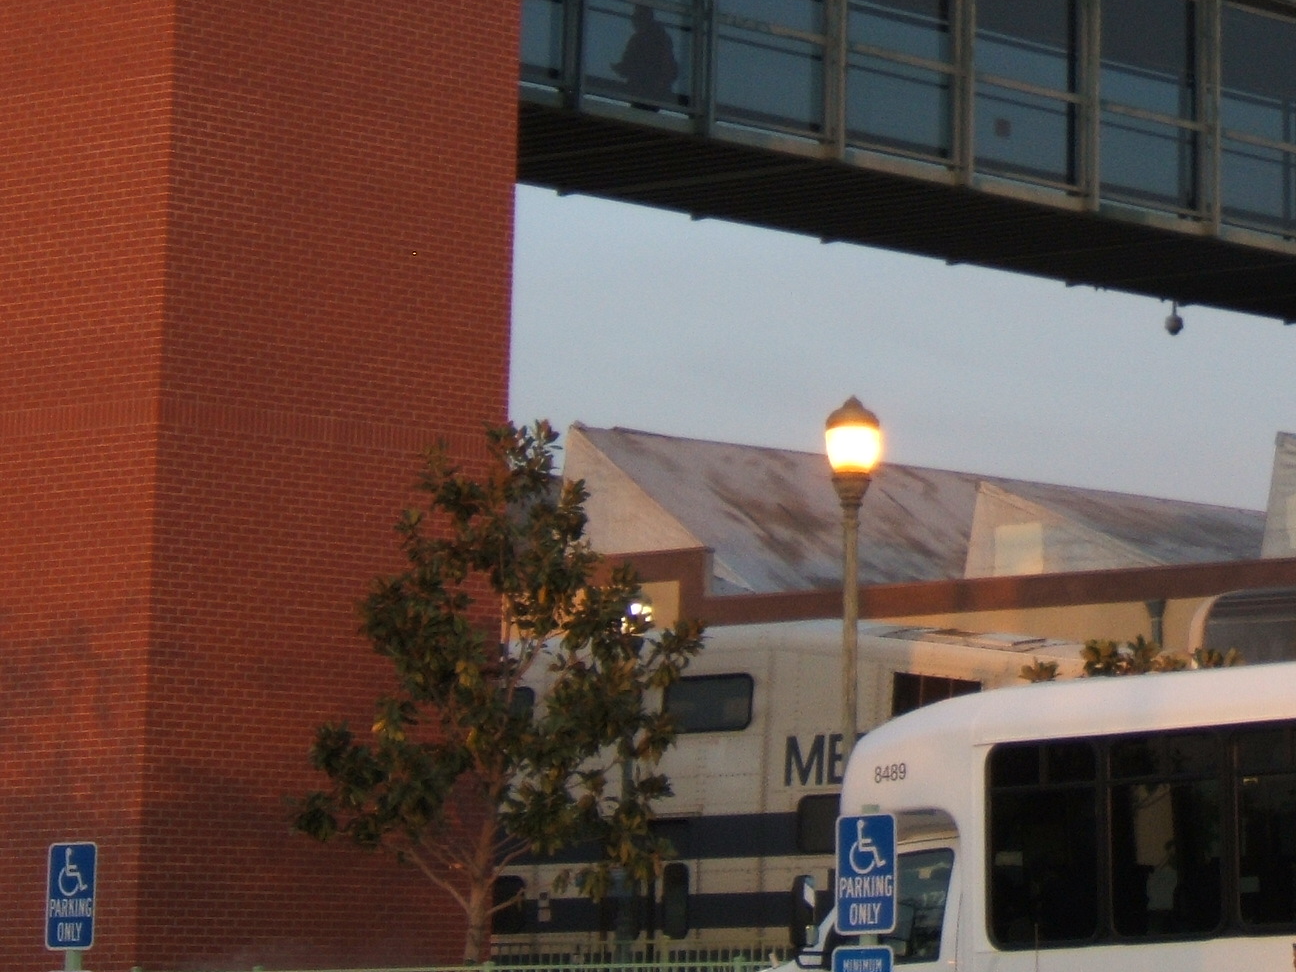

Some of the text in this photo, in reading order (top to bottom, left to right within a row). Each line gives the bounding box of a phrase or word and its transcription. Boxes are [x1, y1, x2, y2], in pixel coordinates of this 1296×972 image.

[784, 732, 867, 787] ME
[874, 762, 906, 784] 8489
[839, 875, 893, 899] PARKING
[49, 897, 92, 918] PARKING
[850, 903, 881, 926] ONLY
[57, 922, 82, 942] ONLY
